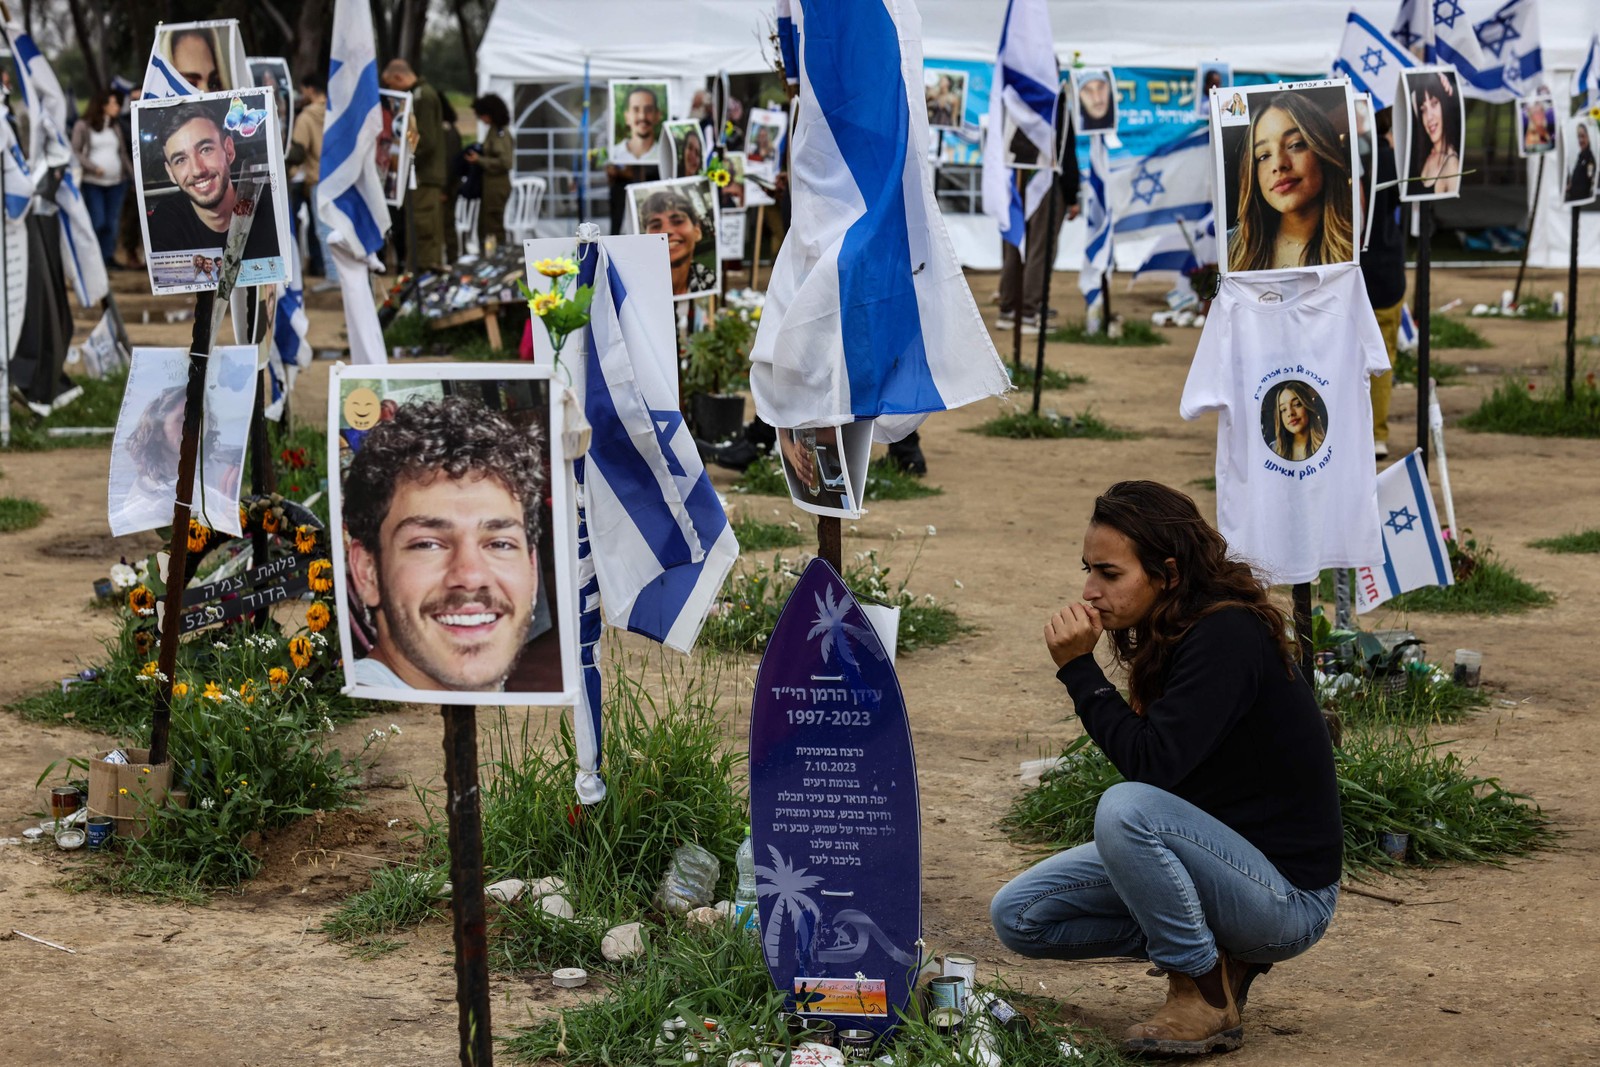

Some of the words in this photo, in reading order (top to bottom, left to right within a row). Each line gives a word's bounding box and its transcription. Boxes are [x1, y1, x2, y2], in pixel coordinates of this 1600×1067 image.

[1296, 364, 1305, 374] של
[1318, 445, 1333, 469] לנצח
[1263, 459, 1295, 477] מאיתנו
[1299, 465, 1317, 480] חלק
[255, 556, 297, 582] פלוגת
[242, 586, 288, 608] גדוד
[810, 688, 847, 704] הרמן
[851, 688, 882, 705] עידן
[787, 710, 871, 726] 1997-2023
[796, 746, 837, 756] במיגונית
[805, 762, 856, 772] 7.10.2023
[803, 778, 827, 787] רעים
[829, 779, 860, 788] בצומת
[778, 791, 804, 802] תכלת
[806, 793, 824, 802] עיני
[827, 794, 841, 803] עם
[844, 795, 868, 804] תואר
[870, 796, 887, 804] יפה
[776, 807, 810, 819] ומצחיק
[813, 810, 834, 818] צנוע
[837, 810, 864, 820] כובש,
[867, 811, 891, 821] וחיוך
[773, 823, 787, 832] וים
[790, 824, 809, 833] טבע
[811, 825, 837, 835] שמש,
[839, 823, 853, 834] של
[810, 839, 832, 849] שלנו
[835, 841, 859, 850] אהוב
[810, 854, 828, 865] לעד
[830, 855, 861, 866] בליבנו
